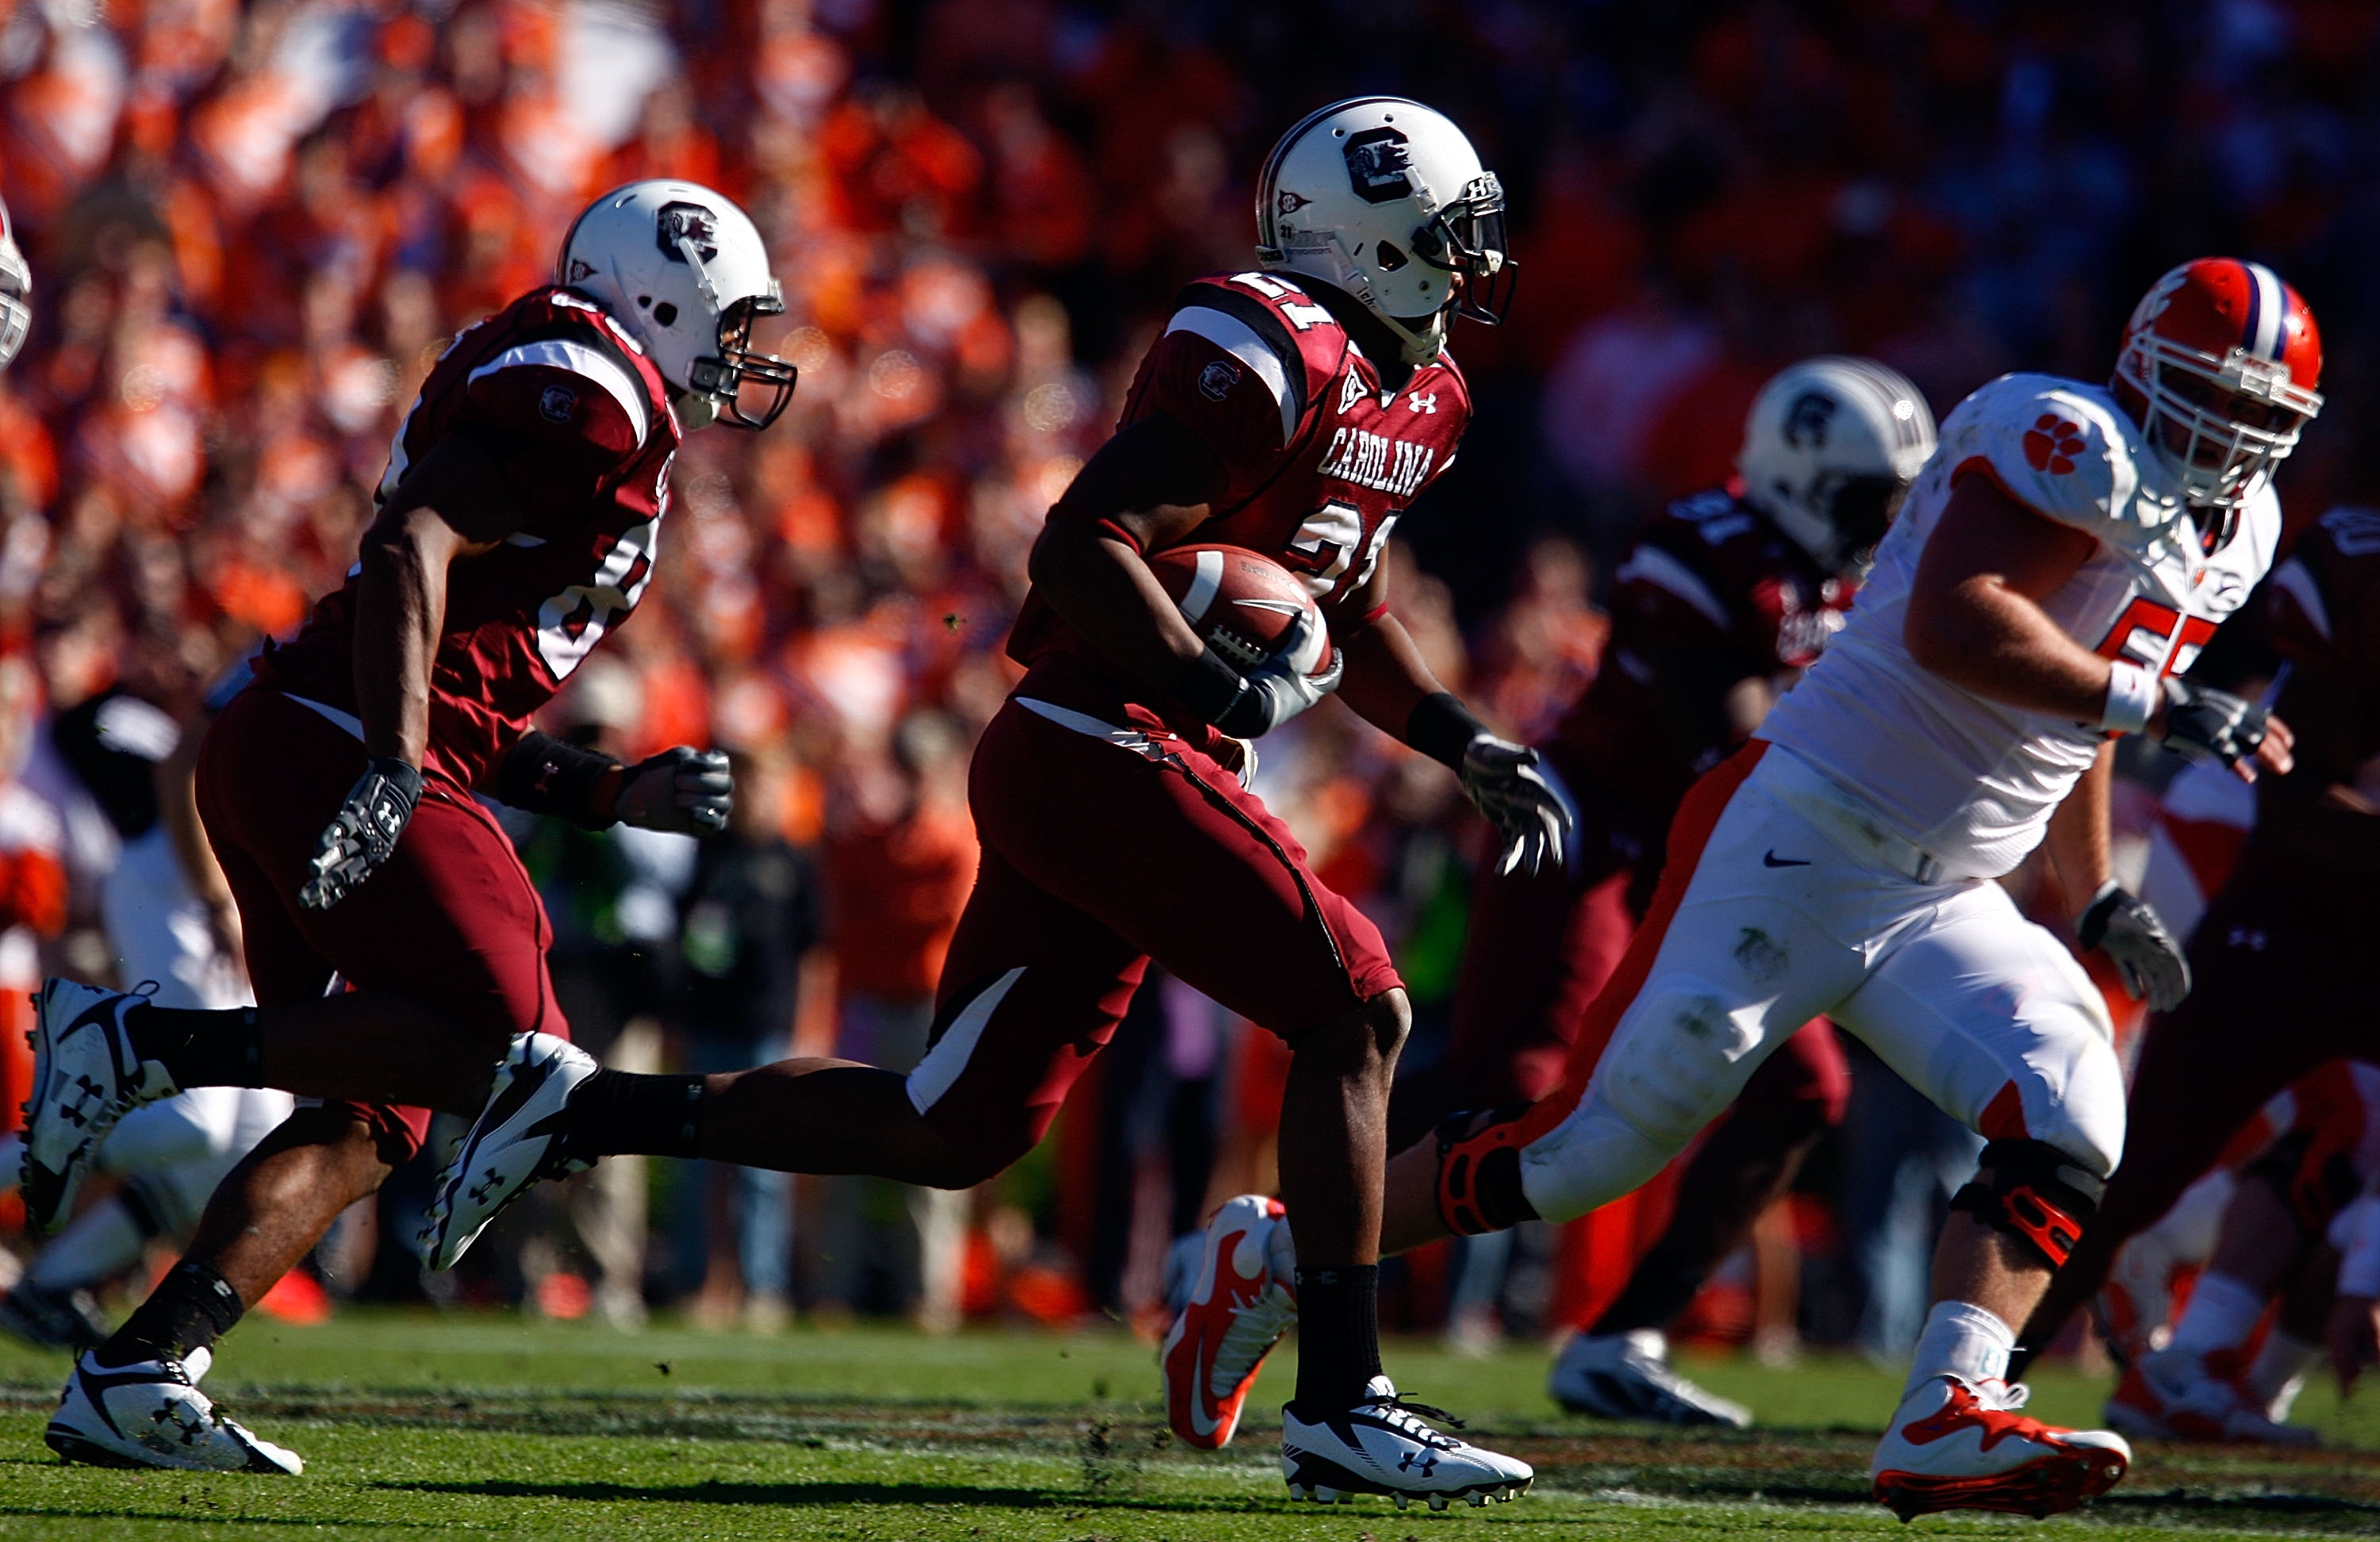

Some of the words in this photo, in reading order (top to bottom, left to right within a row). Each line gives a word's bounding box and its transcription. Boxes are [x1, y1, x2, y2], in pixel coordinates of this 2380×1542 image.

[1280, 224, 1292, 239] 21
[1228, 271, 1334, 332] 21
[1317, 427, 1434, 497] CAROLINA
